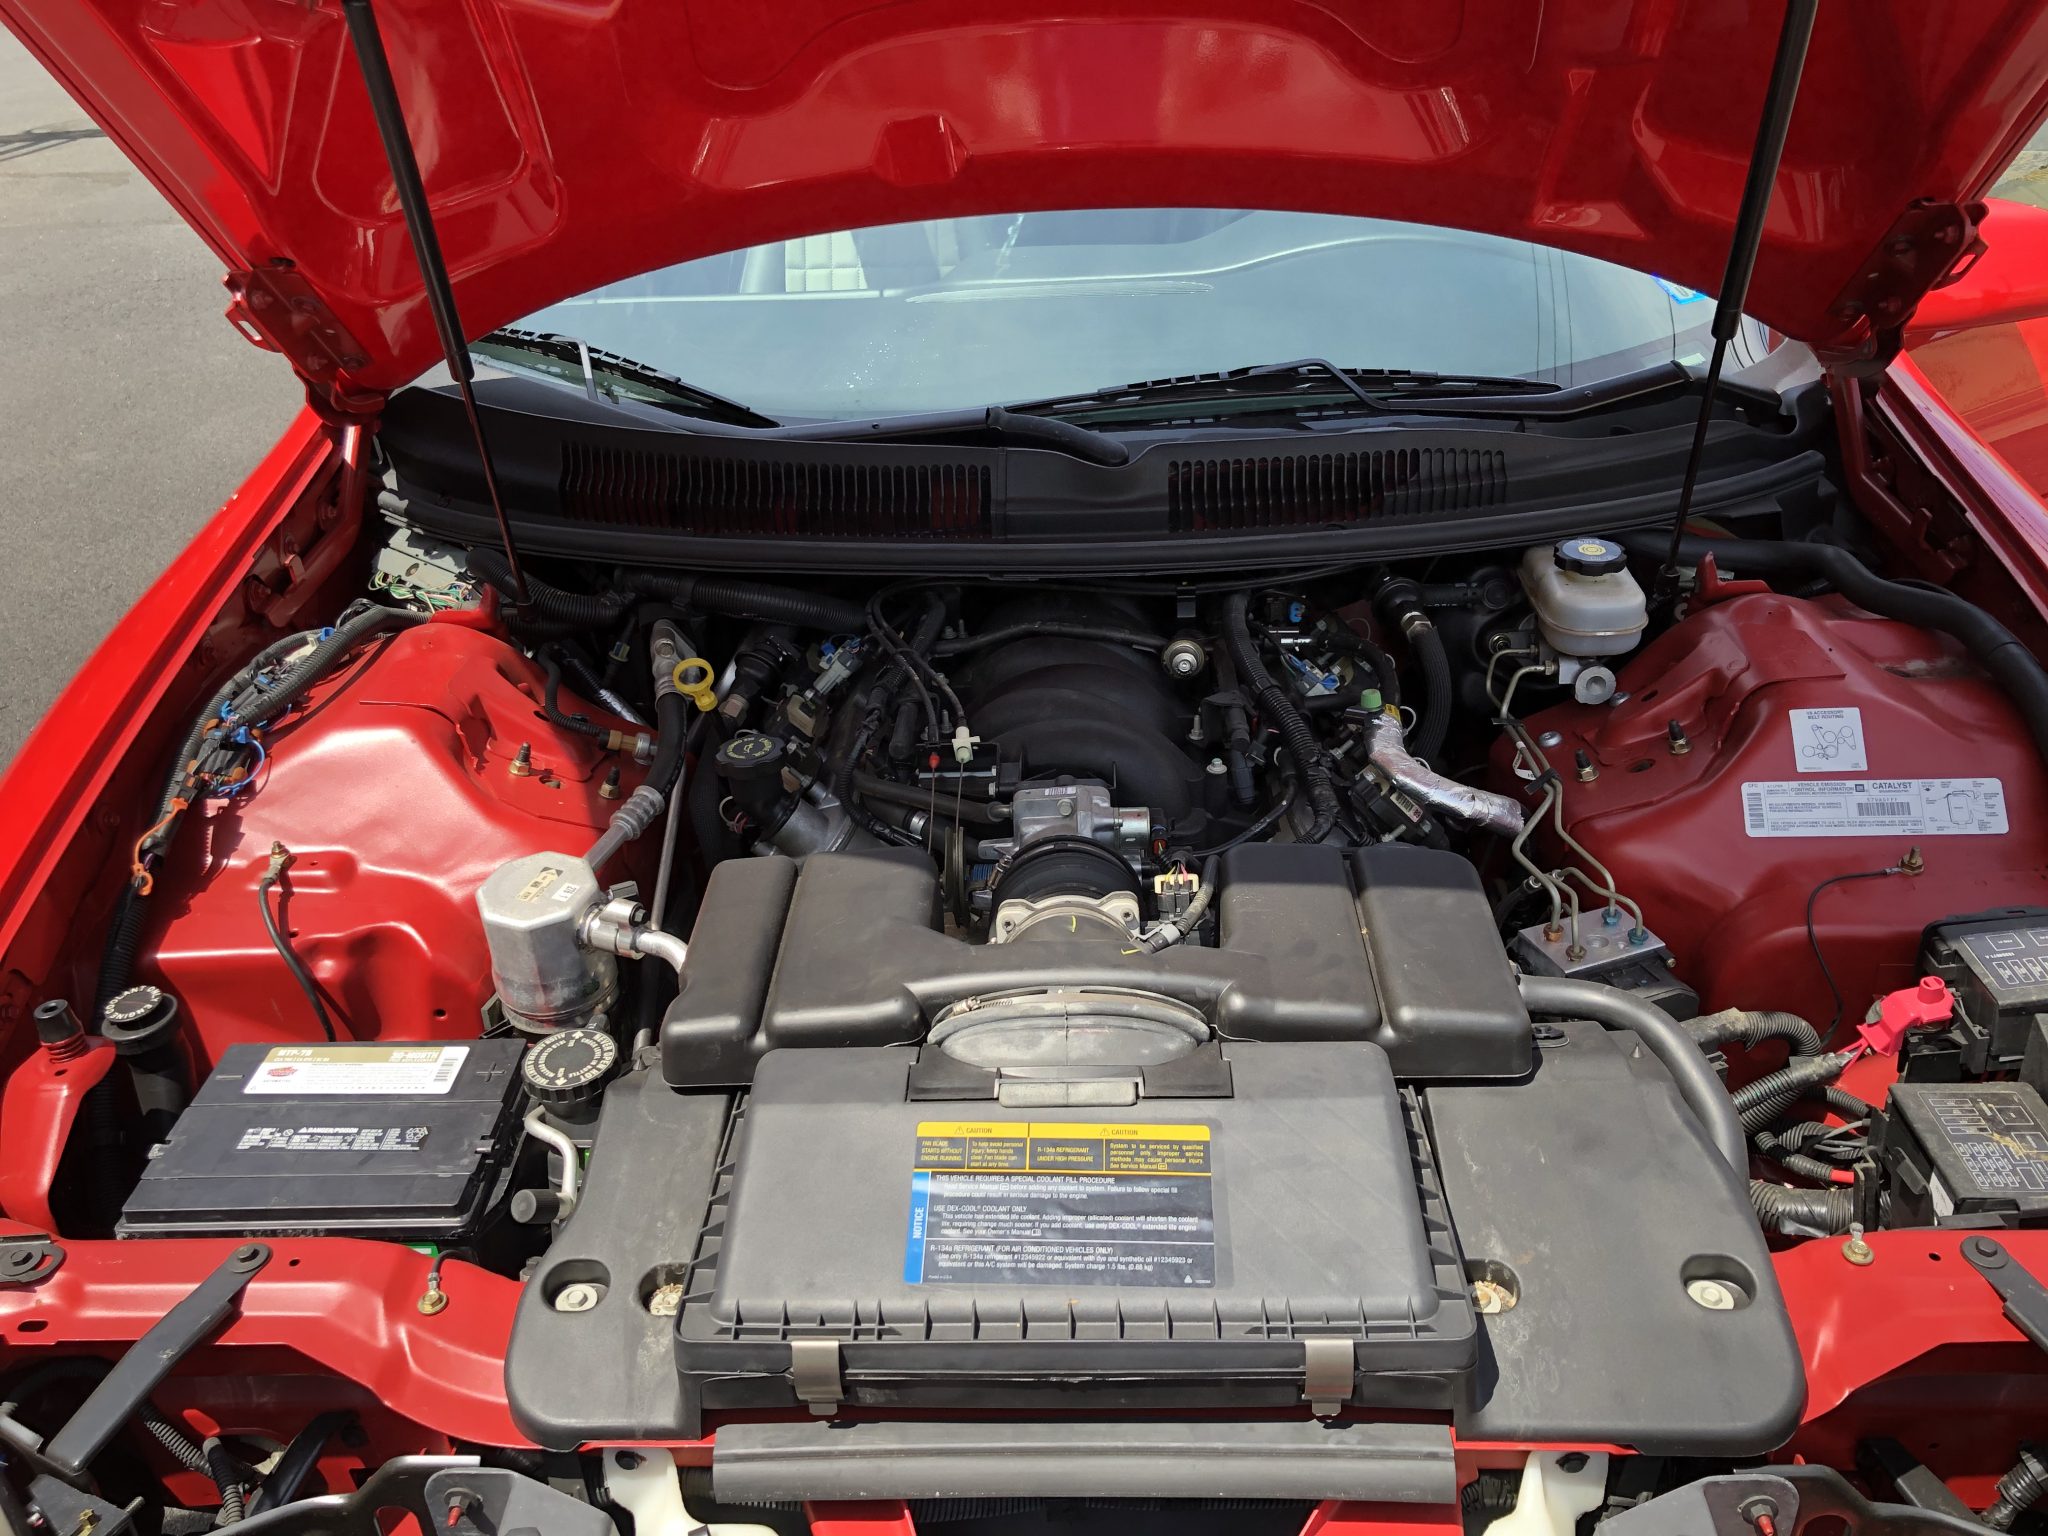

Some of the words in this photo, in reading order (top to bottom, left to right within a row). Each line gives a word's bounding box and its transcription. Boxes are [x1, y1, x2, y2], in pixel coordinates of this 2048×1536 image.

[104, 985, 146, 1014] COOLANT
[147, 986, 161, 1002] ONLY
[110, 1004, 153, 1019] ENGINE
[592, 1033, 612, 1051] NEVER
[596, 1052, 613, 1069] OPEN
[568, 1065, 592, 1078] BOTTLE
[580, 1069, 599, 1082] HOT
[913, 1207, 924, 1238] NOTICE
